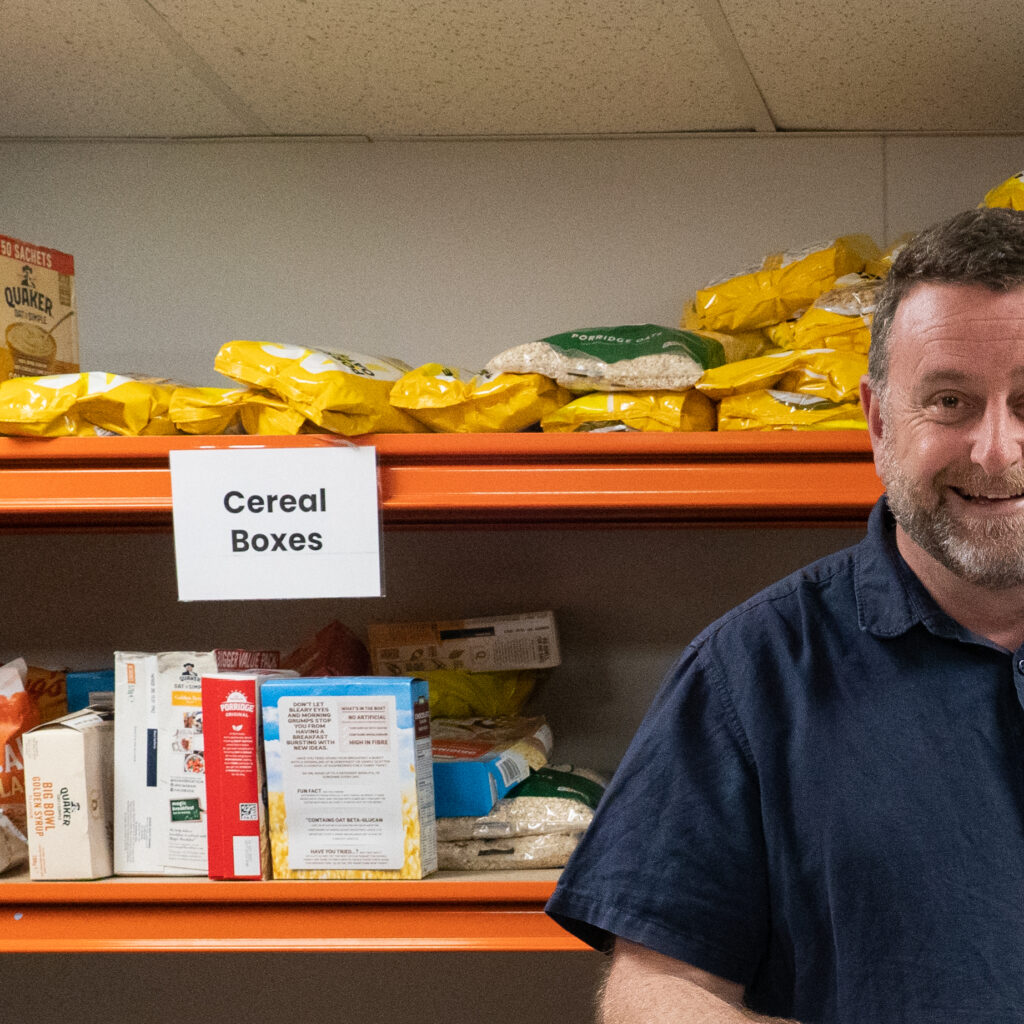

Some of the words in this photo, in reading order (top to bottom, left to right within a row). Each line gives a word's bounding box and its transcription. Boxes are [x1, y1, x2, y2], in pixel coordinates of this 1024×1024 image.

[14, 243, 52, 268] SACHETS
[4, 286, 53, 317] QUAKER
[571, 333, 632, 344] PORRIDGE
[223, 488, 327, 514] Cereal
[231, 529, 323, 553] Boxes
[31, 776, 42, 808] GOLDEN
[42, 782, 54, 799] BIG
[43, 802, 56, 831] BOWL
[60, 787, 71, 827] QUAKER
[34, 810, 44, 837] SYRUP
